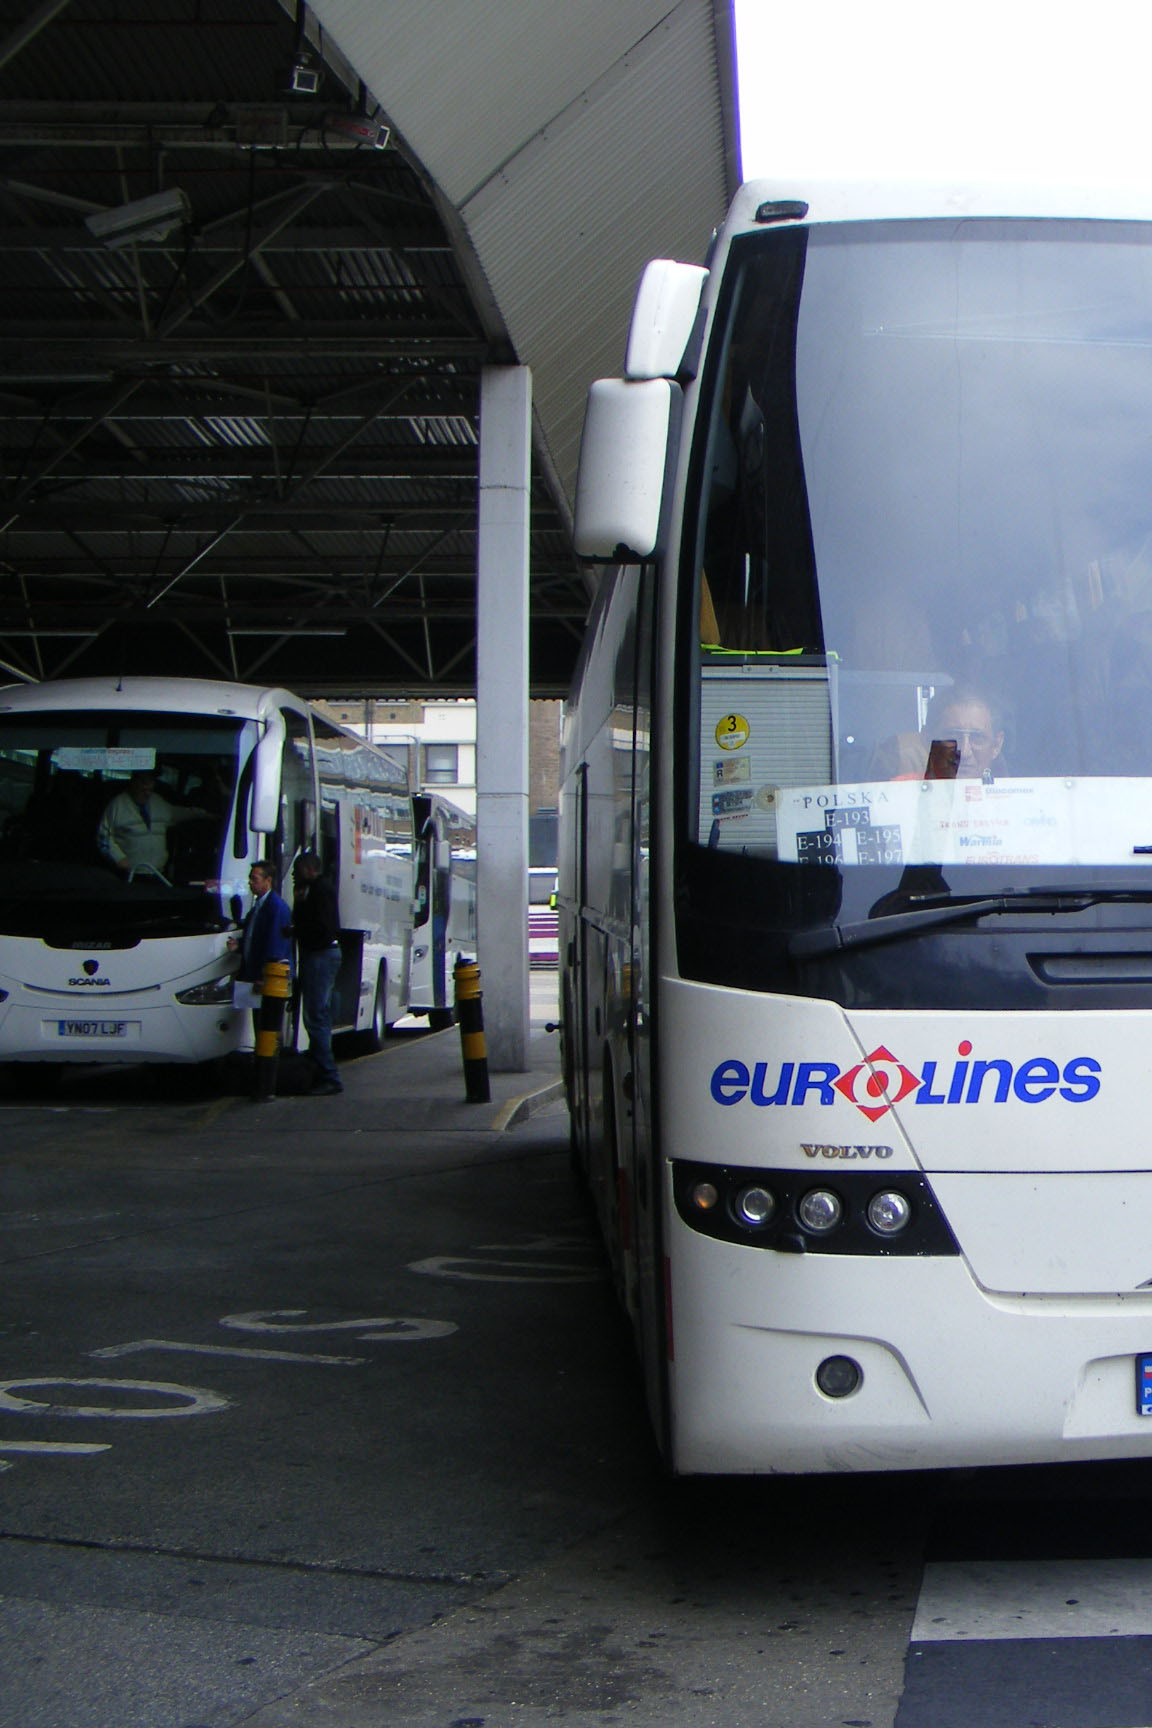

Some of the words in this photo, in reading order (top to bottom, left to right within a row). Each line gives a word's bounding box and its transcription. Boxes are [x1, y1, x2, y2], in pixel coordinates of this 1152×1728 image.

[727, 714, 738, 732] 3
[716, 769, 724, 778] R
[802, 790, 889, 809] POLSKA
[825, 810, 870, 827] E-193
[797, 833, 842, 850] E-194
[856, 828, 901, 846] E-195
[959, 836, 1003, 848] Warmia
[858, 849, 904, 864] E-197
[68, 977, 111, 986] SCANIA
[66, 1021, 98, 1035] YN07
[101, 1021, 126, 1035] LJF
[800, 1143, 894, 1159] VOLVO
